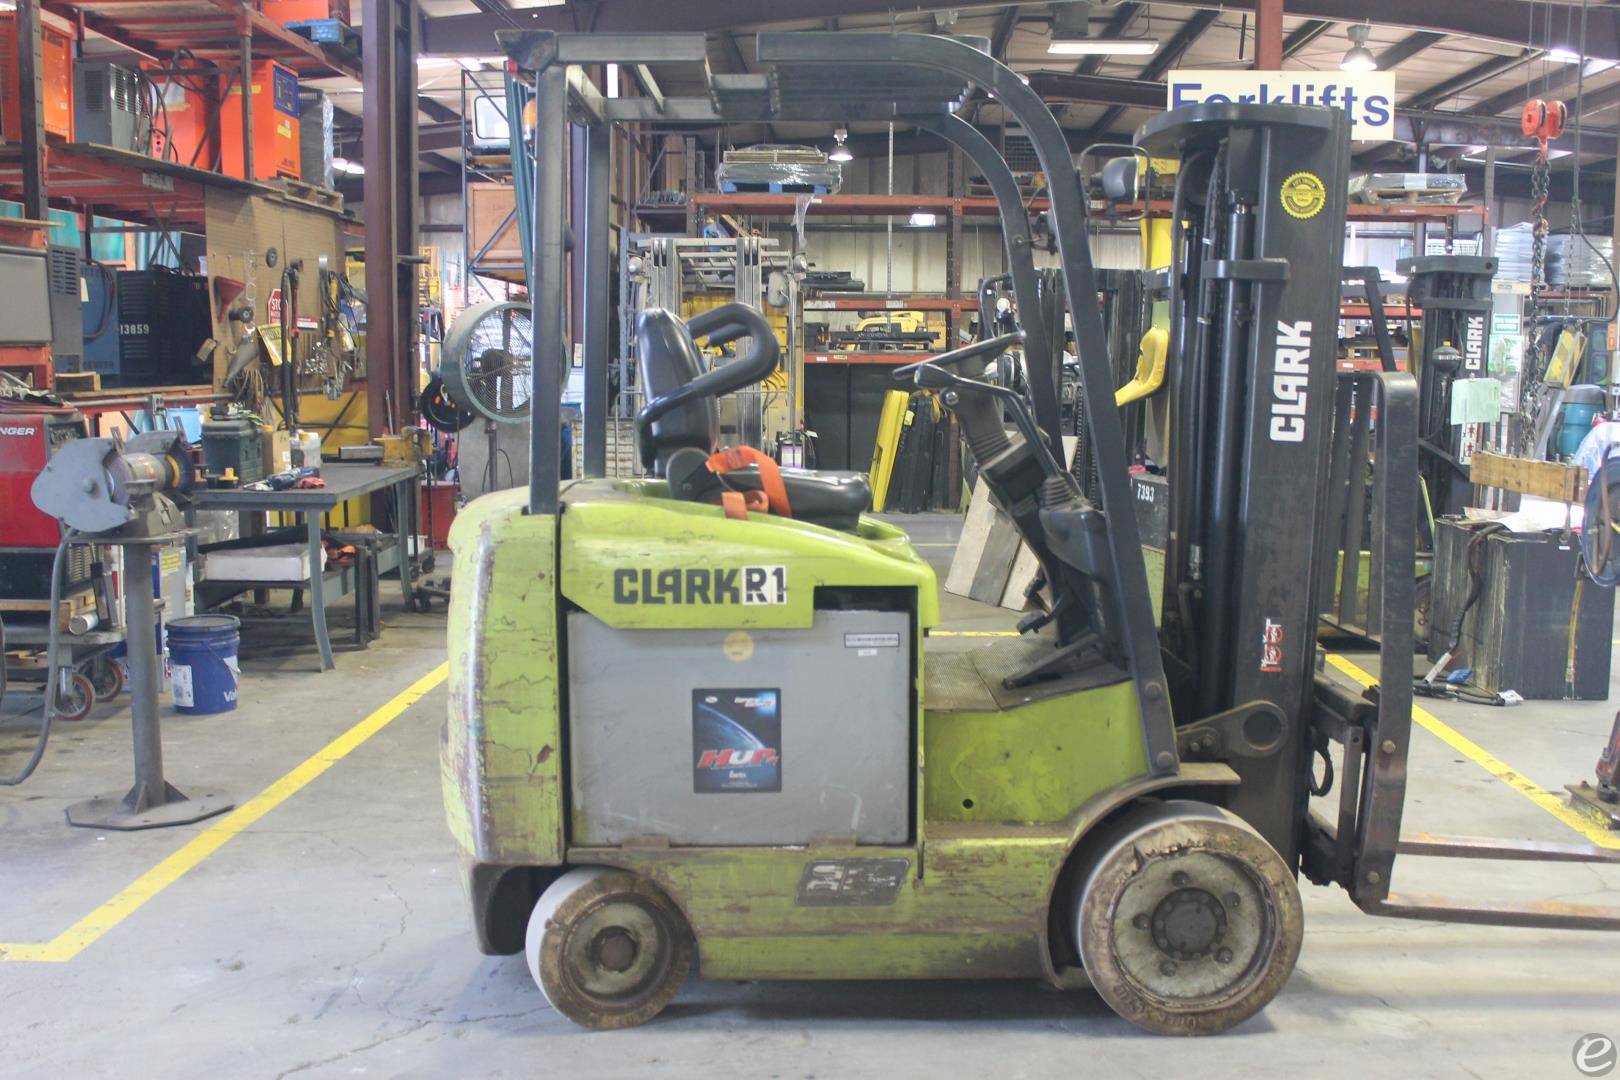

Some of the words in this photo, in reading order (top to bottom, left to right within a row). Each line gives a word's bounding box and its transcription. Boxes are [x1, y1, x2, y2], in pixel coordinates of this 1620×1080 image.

[1172, 83, 1391, 127] Fklifts
[1465, 316, 1484, 370] CLARK
[1269, 320, 1312, 442] CLARK
[1137, 482, 1155, 503] 7393
[613, 568, 740, 605] CLARK
[745, 567, 784, 603] R1
